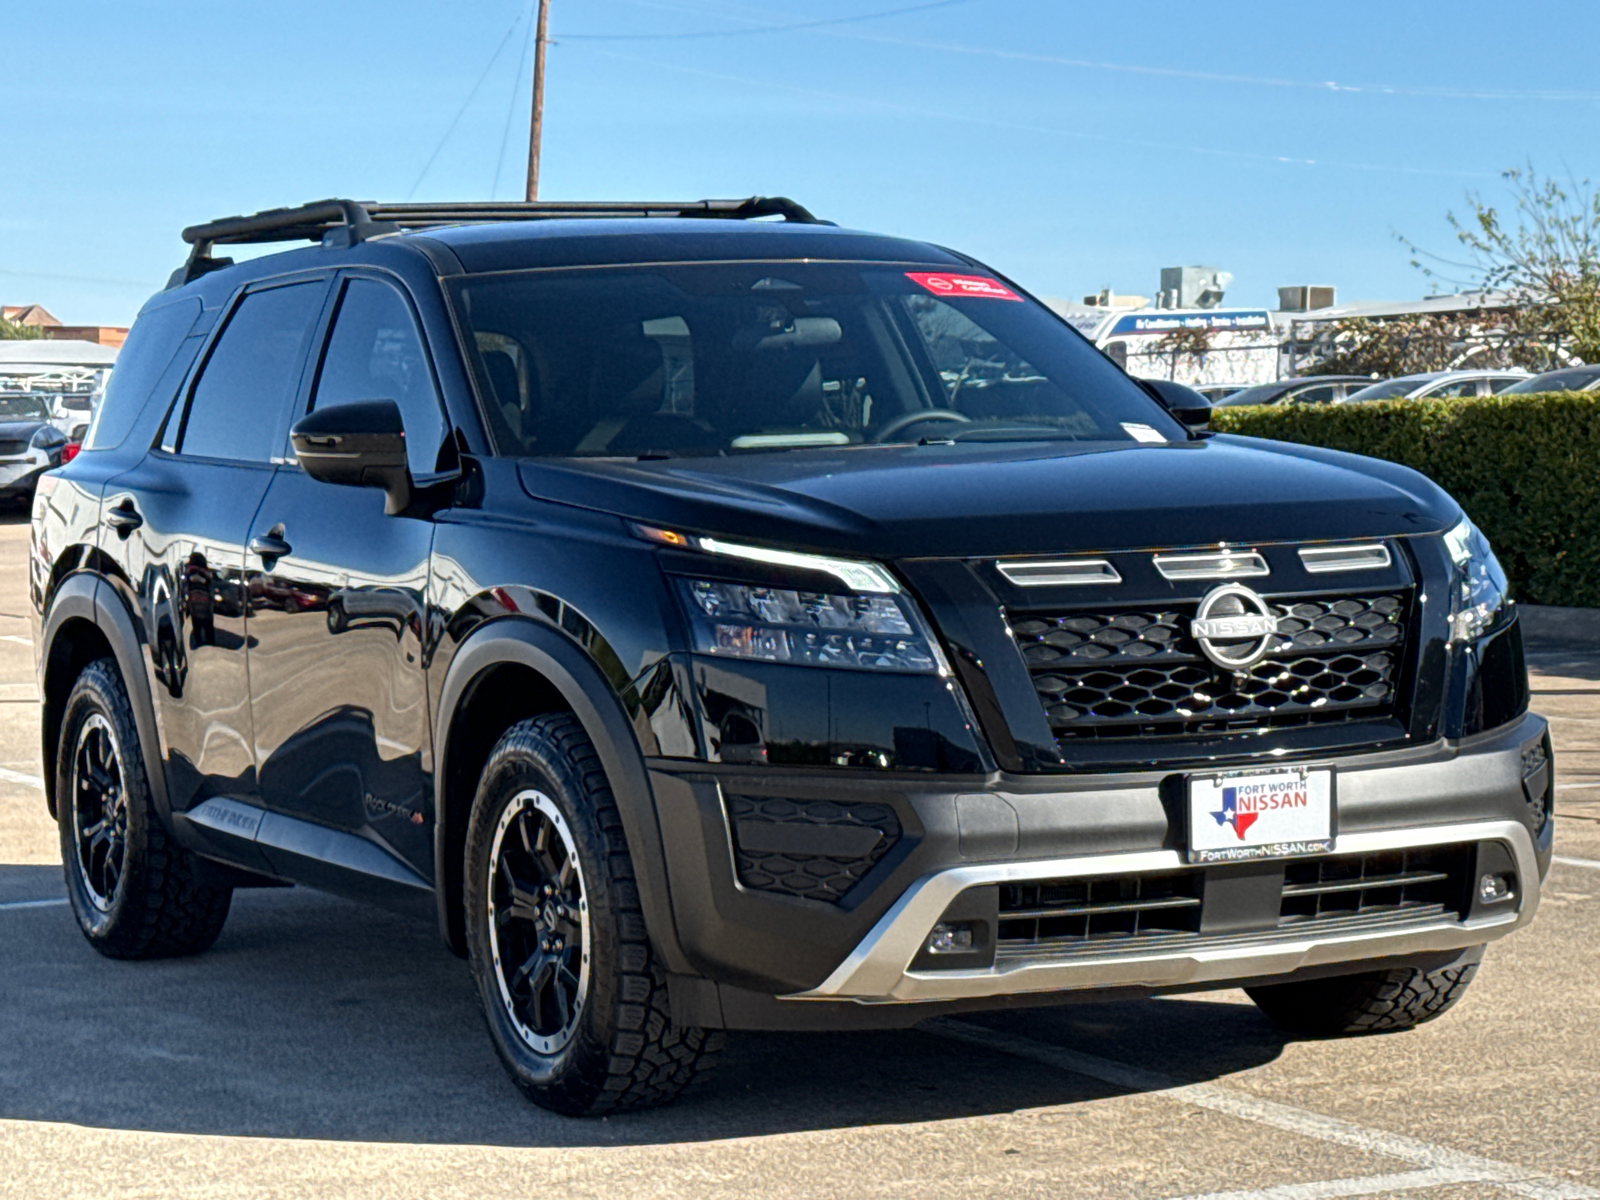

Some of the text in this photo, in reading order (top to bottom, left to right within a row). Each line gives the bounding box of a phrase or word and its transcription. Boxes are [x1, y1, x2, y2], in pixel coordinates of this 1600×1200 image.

[1194, 621, 1276, 636] NISSAN
[1238, 781, 1307, 795] FORT WORTH
[1238, 791, 1307, 812] NISSAN
